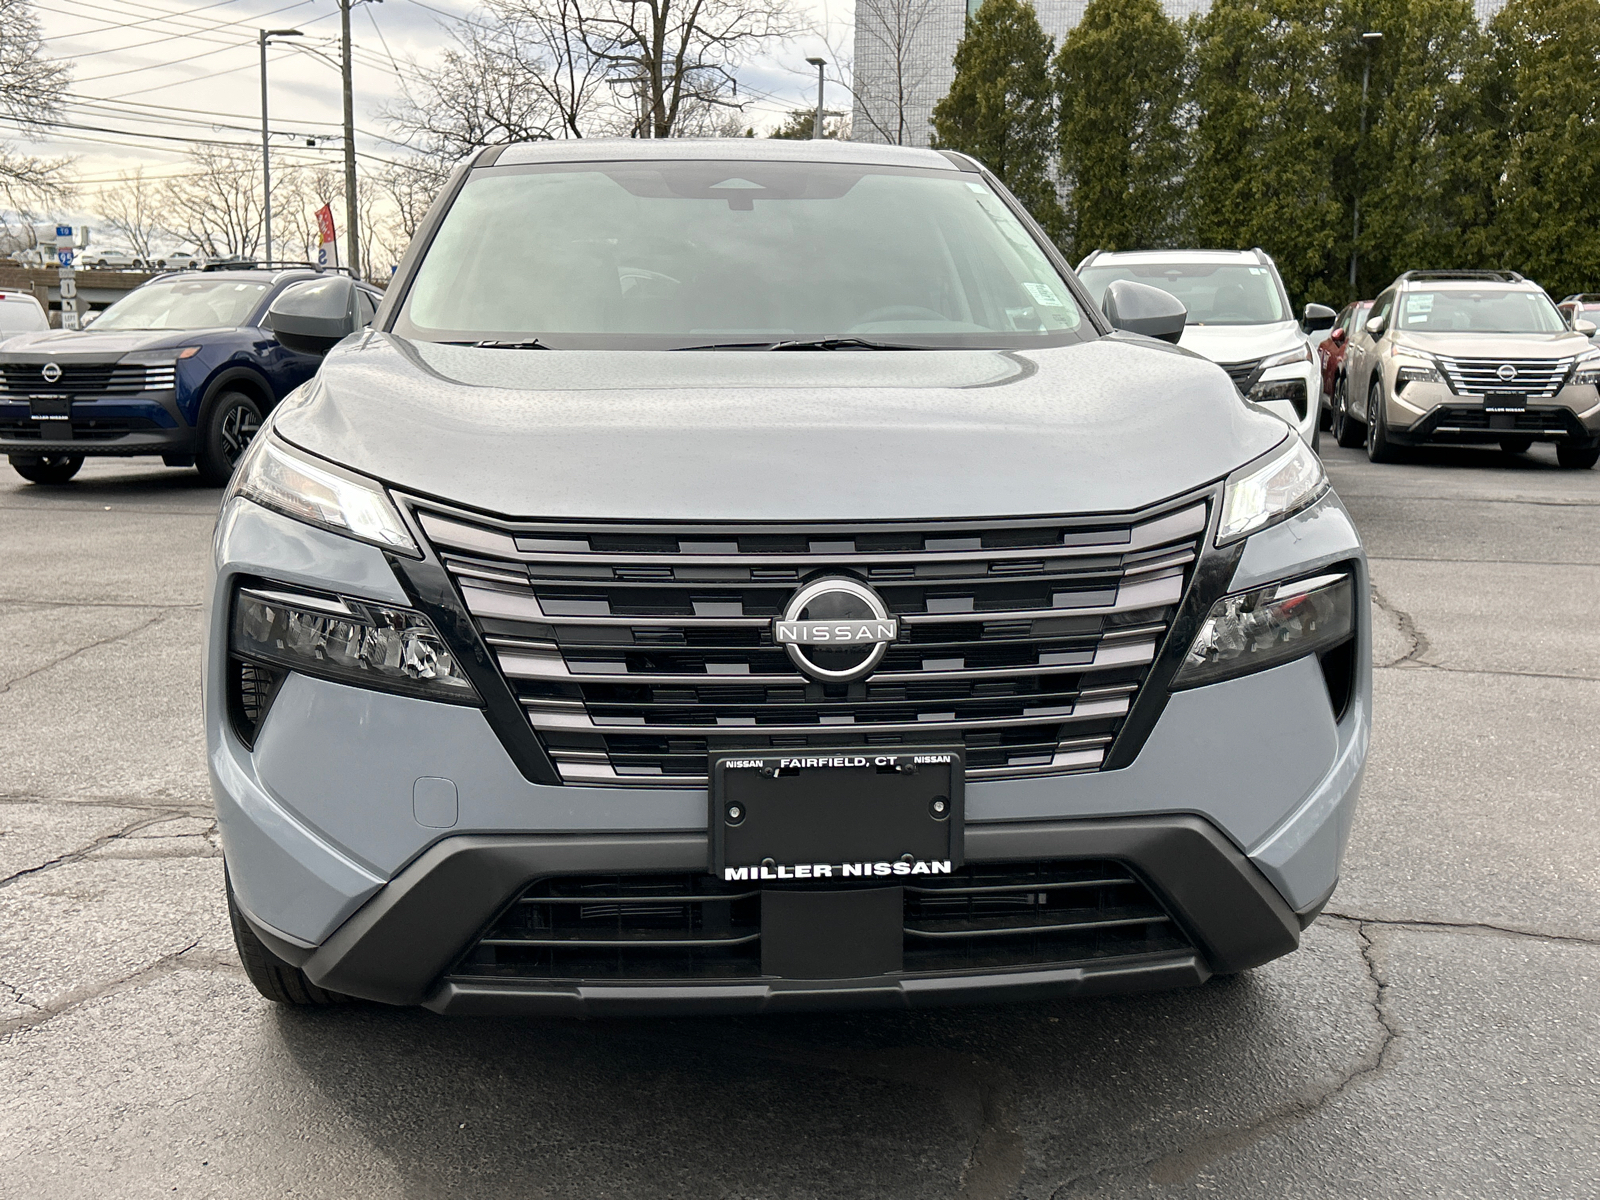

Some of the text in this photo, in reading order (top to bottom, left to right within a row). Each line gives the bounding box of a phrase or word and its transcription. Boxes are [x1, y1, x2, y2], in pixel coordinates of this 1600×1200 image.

[60, 253, 72, 264] 95
[779, 623, 895, 641] NISSAN
[725, 755, 951, 769] NISSAN FAIRFIELD, CT NISSAN
[724, 861, 952, 881] MILLER NISSAN
